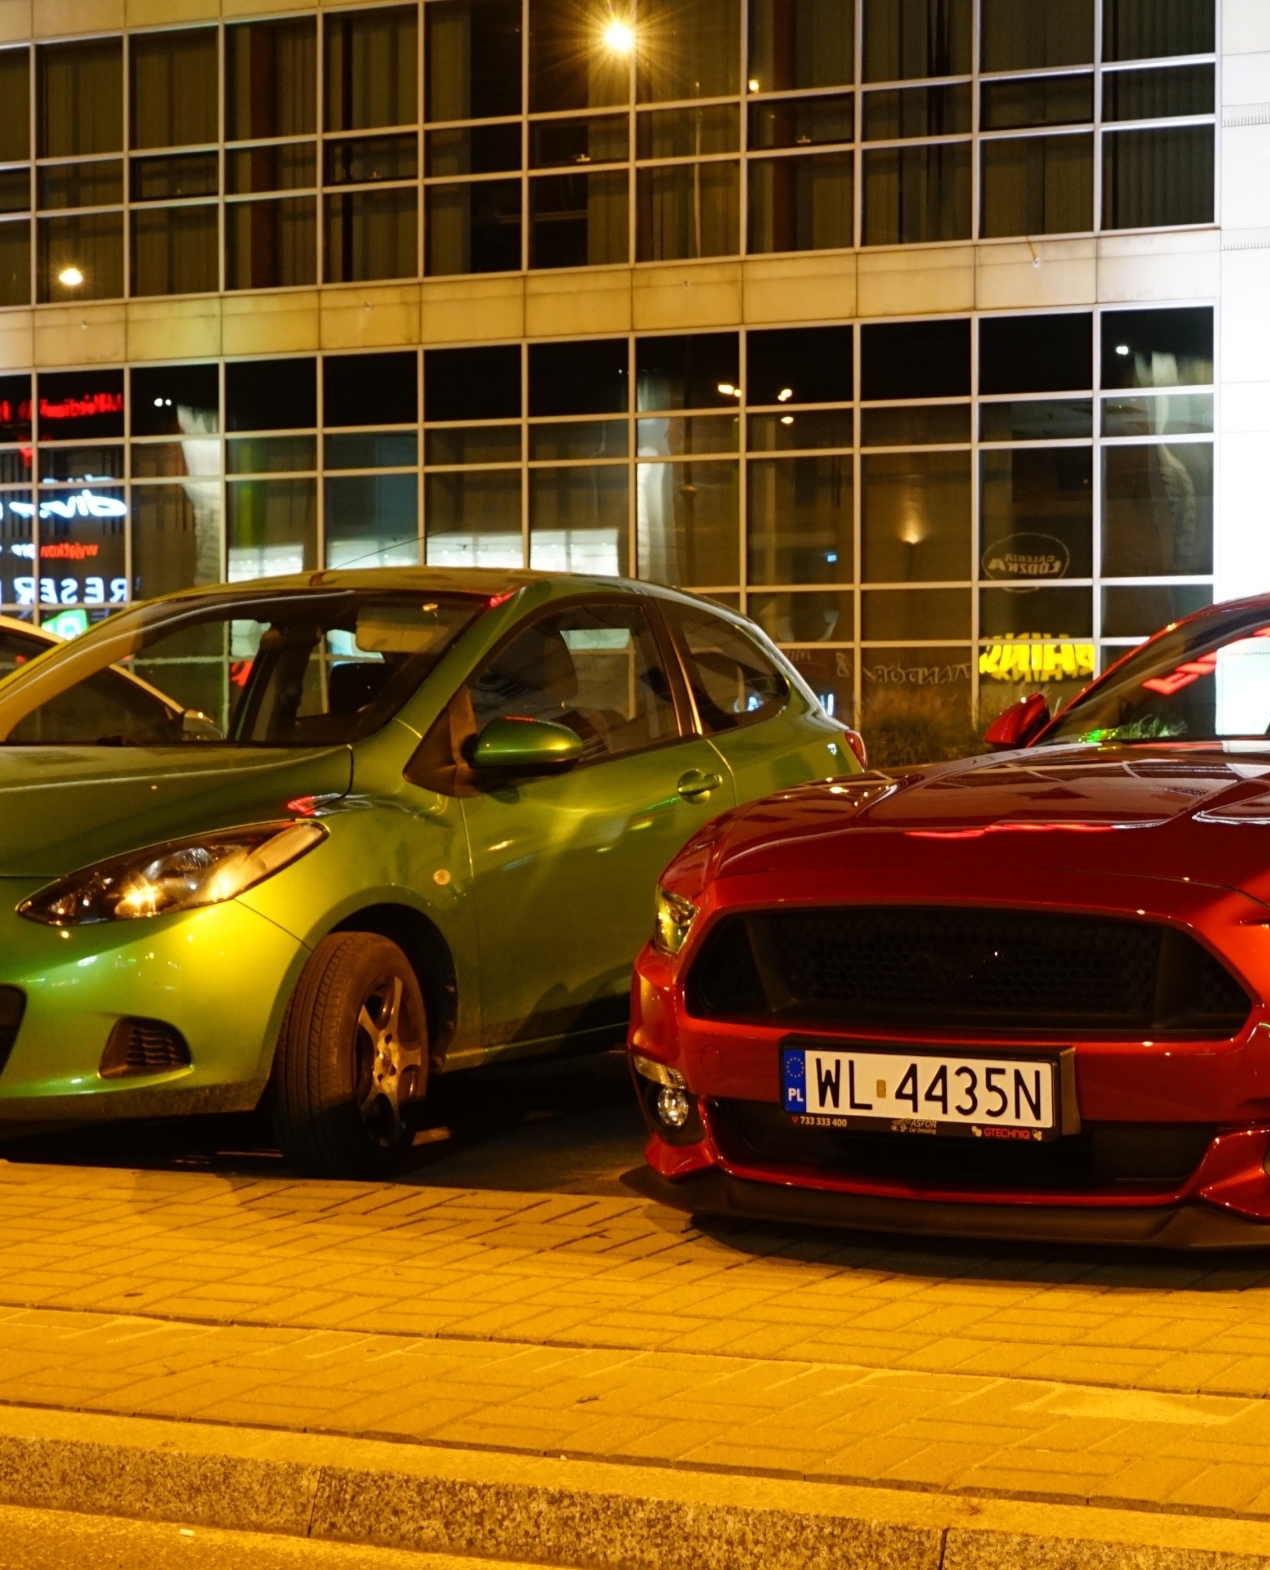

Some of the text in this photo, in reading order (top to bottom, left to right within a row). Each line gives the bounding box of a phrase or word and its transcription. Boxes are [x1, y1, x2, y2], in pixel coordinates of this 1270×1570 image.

[788, 1087, 804, 1102] PL
[815, 1058, 1042, 1121] WL 4435N
[800, 1116, 847, 1128] 733 333 400
